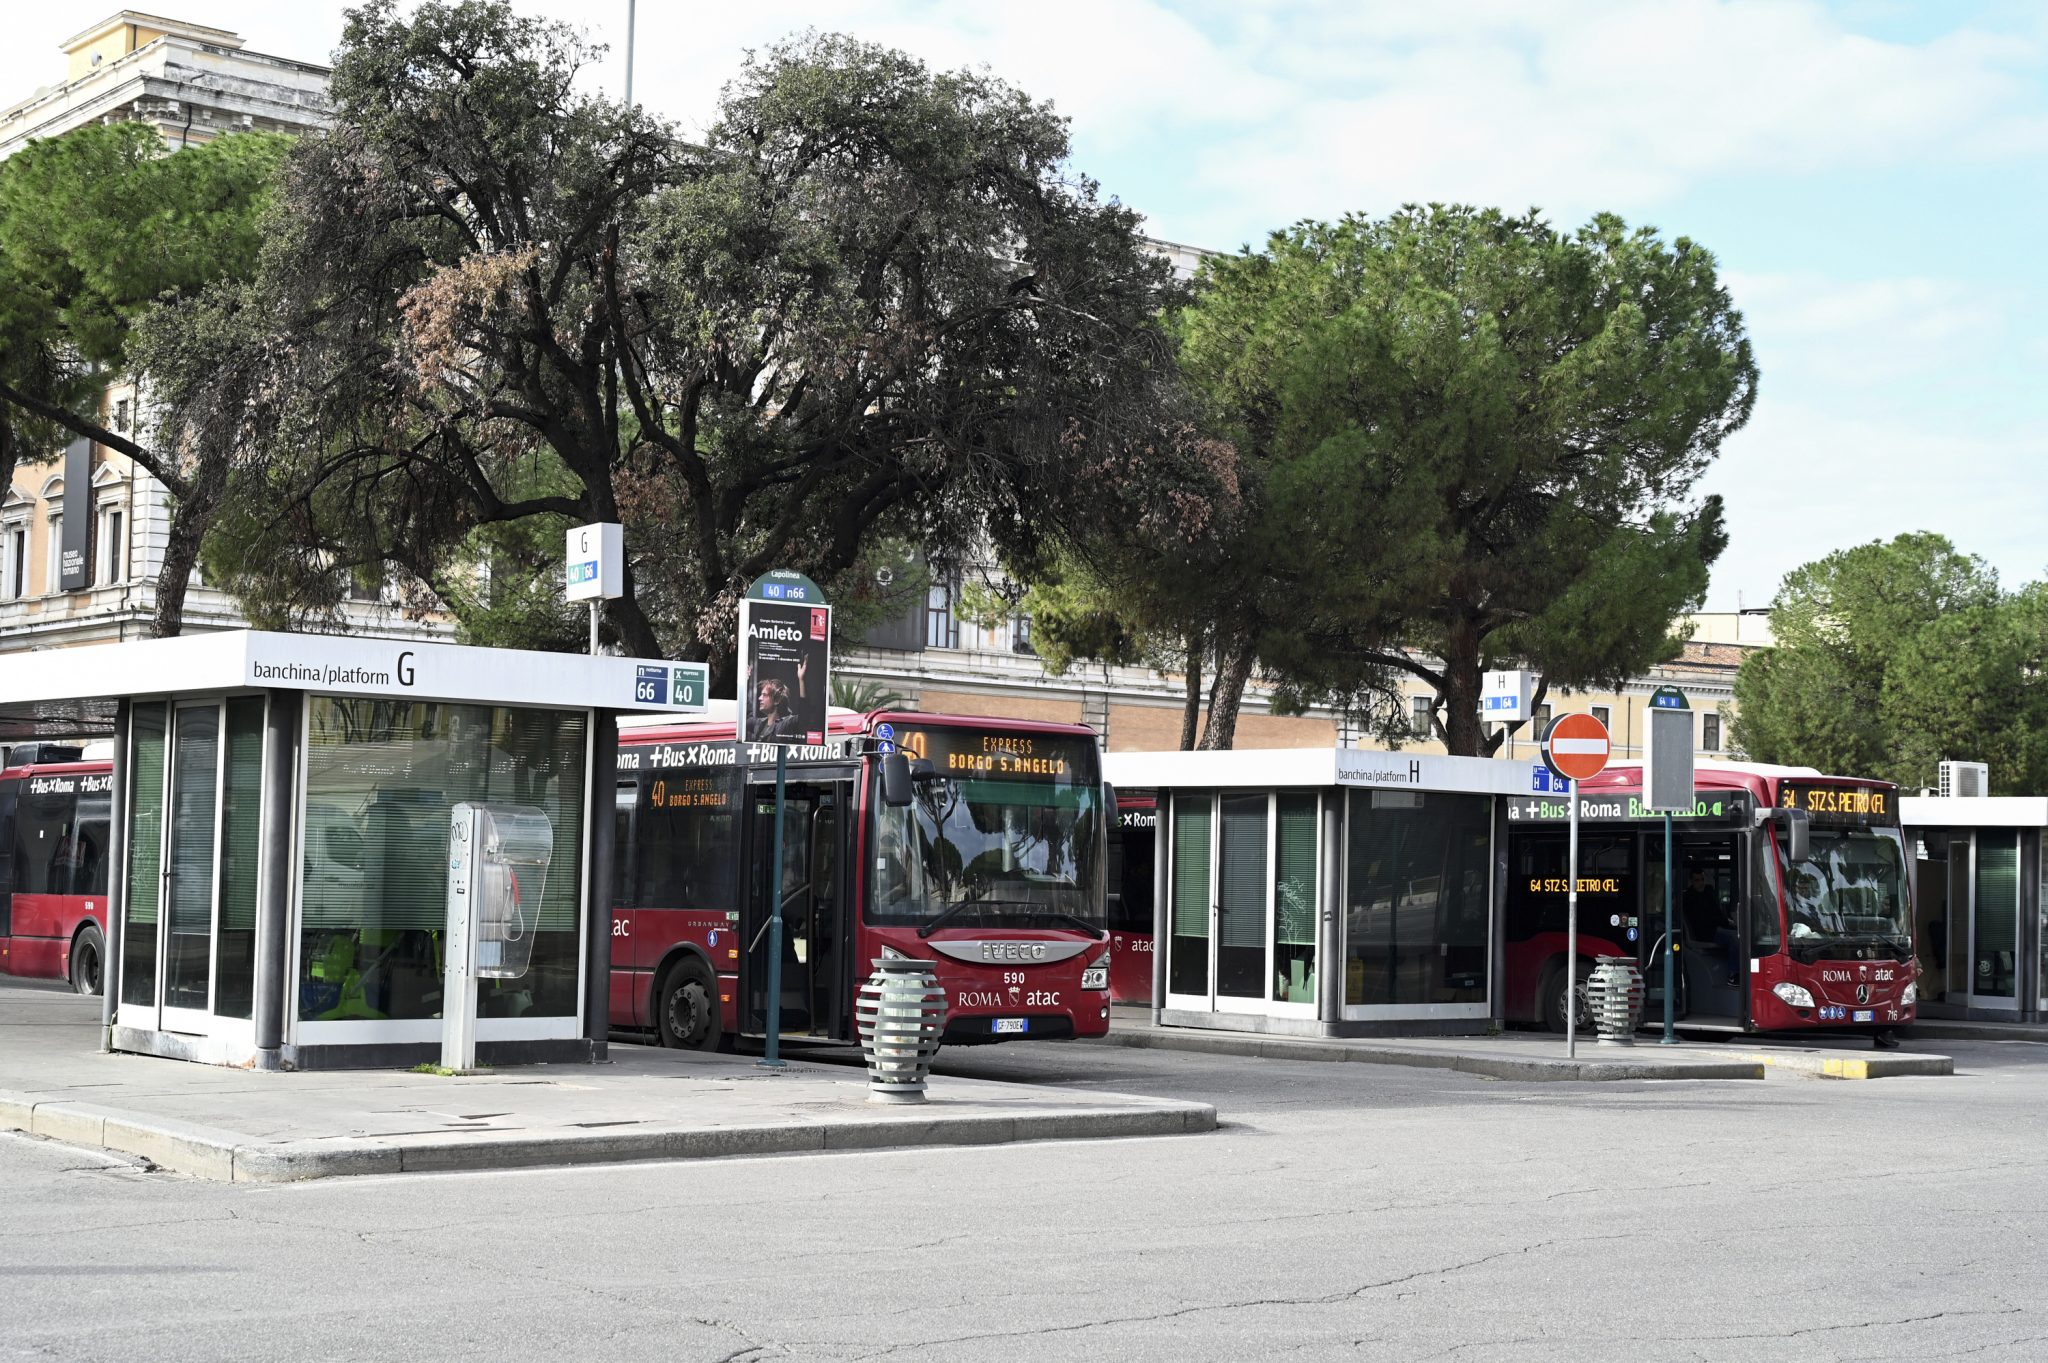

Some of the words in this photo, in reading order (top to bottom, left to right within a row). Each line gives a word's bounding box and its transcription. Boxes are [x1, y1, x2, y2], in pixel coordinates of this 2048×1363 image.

[581, 532, 588, 553] G
[771, 570, 800, 579] Capolinea
[768, 585, 780, 597] 40
[787, 587, 804, 599] n66
[748, 623, 802, 641] Amleto
[254, 661, 389, 685] banchina/platform
[397, 651, 415, 686] G
[638, 667, 645, 676] n
[1498, 675, 1506, 688] H
[637, 682, 655, 700] 66
[675, 685, 693, 703] 40
[983, 736, 1032, 754] EXPRESS
[949, 753, 993, 770] BORGO
[1338, 767, 1407, 783] banchina/platform
[1409, 759, 1420, 783] H
[685, 779, 713, 791] EXPRESS
[1533, 777, 1540, 789] H
[1553, 779, 1563, 791] 64
[652, 780, 665, 807] 40
[669, 794, 691, 806] BORGO
[1808, 790, 1826, 811] STZ
[1530, 879, 1541, 892] 64
[1544, 879, 1560, 892] STZ
[1576, 879, 1601, 892] IETRO
[611, 919, 630, 936] ac
[983, 943, 1046, 959] IVECO
[1003, 972, 1025, 984] 590
[1823, 970, 1852, 982] ROMA
[1875, 968, 1894, 981] atac
[958, 992, 1002, 1006] ROMA
[1026, 989, 1060, 1006] atac
[1887, 1010, 1898, 1021] 716
